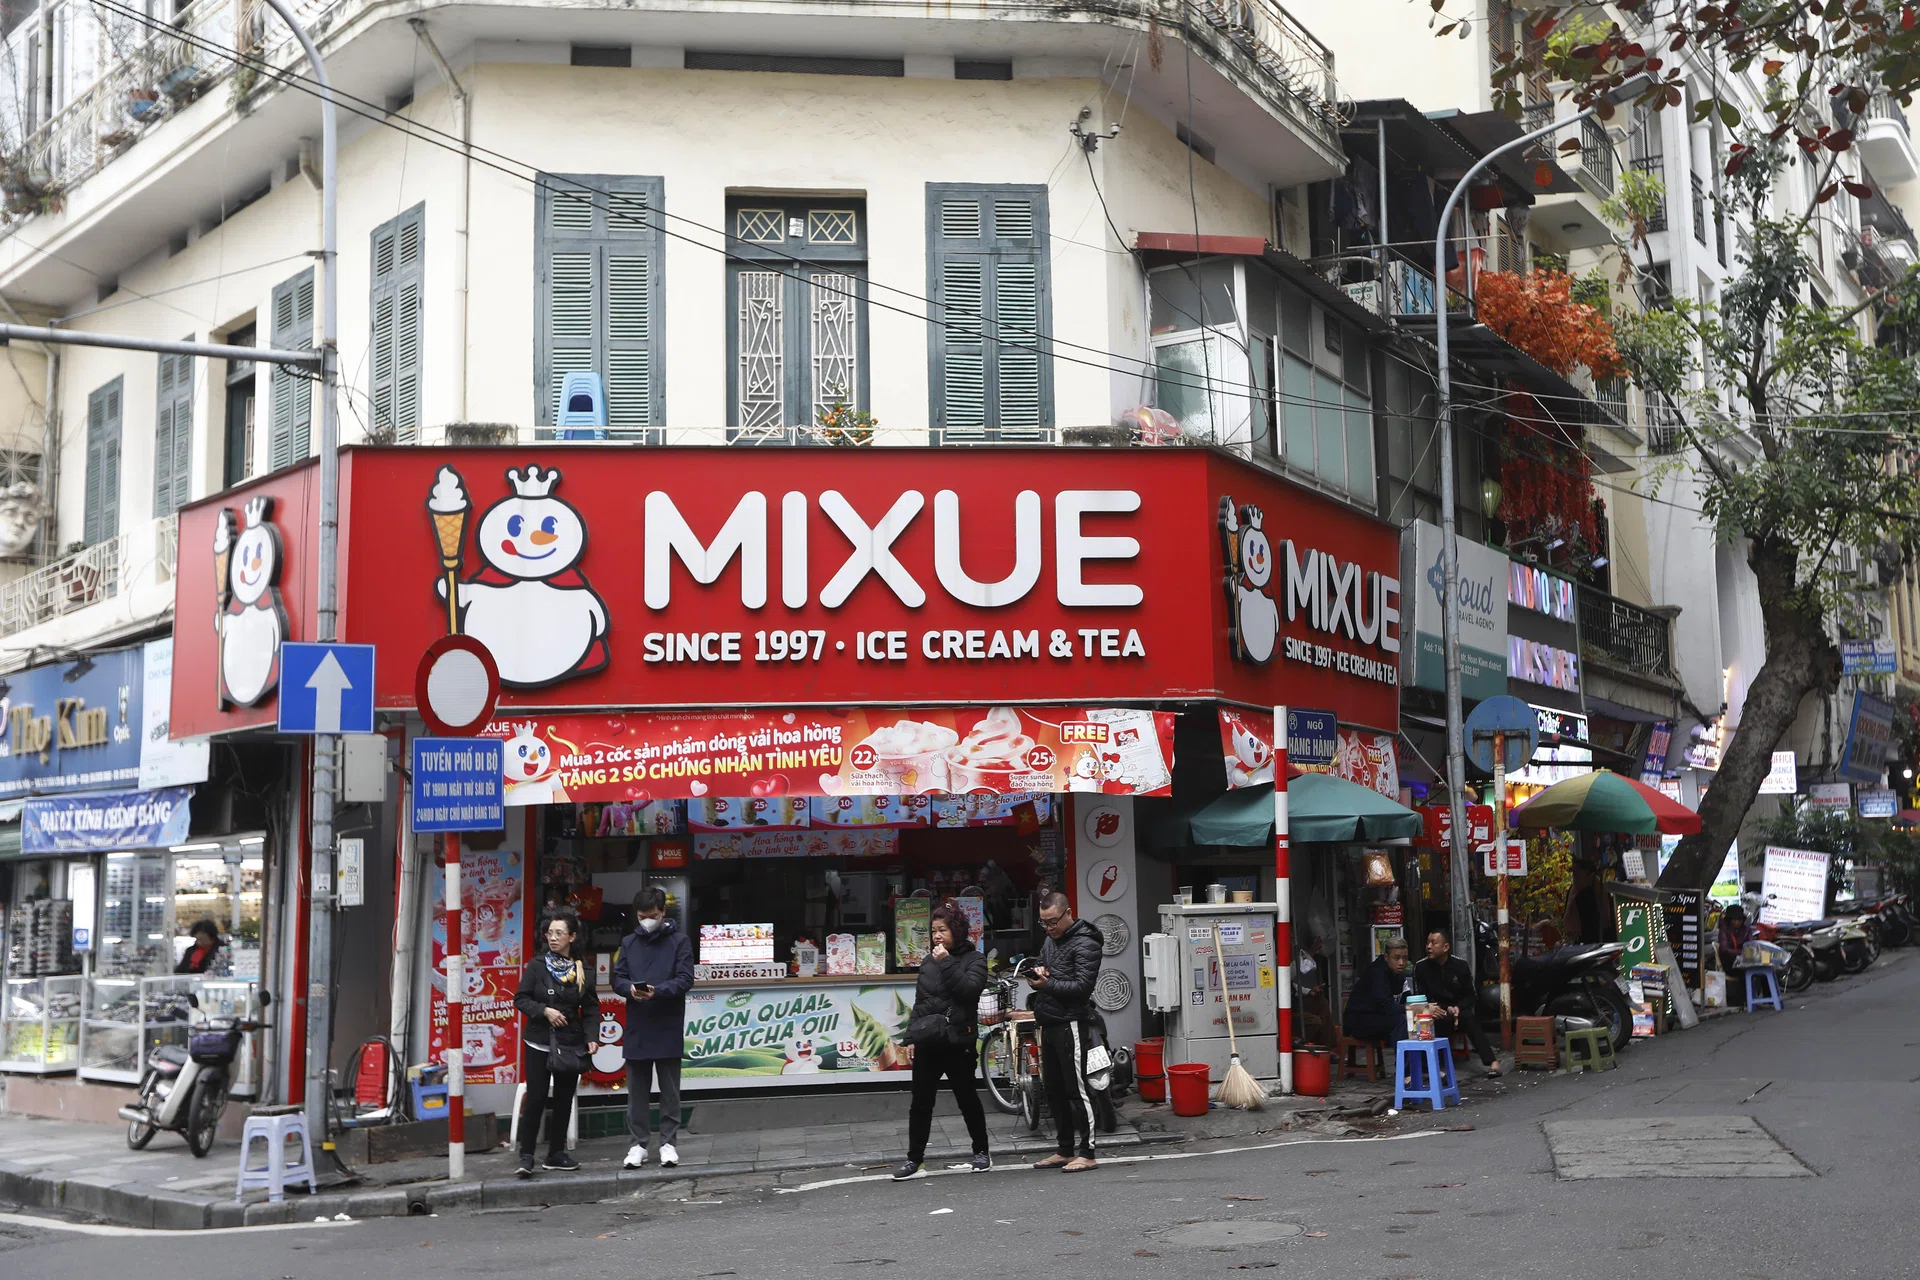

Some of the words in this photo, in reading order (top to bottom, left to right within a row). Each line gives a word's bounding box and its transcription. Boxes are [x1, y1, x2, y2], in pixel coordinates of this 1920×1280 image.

[644, 489, 1144, 609] MIXUE
[1434, 571, 1442, 584] Ms
[1286, 539, 1400, 653] MIXUE
[1552, 576, 1575, 623] SPA
[1458, 611, 1474, 625] RAVEL
[1475, 617, 1495, 631] AGENCY
[643, 632, 742, 662] SINCE
[755, 630, 826, 661] 1997
[856, 630, 907, 660] ICE
[922, 629, 1040, 659] CREAM
[1078, 629, 1146, 658] TEA
[1286, 636, 1311, 664] SINCE
[1314, 645, 1332, 668] 1997
[1337, 651, 1349, 673] ICE
[1350, 654, 1377, 680] CREAM
[1507, 634, 1580, 693] MASSAGE
[10, 704, 50, 765] Thọ
[56, 697, 108, 749] Kim
[481, 722, 510, 733] XUE
[1064, 725, 1107, 741] FREE
[1307, 718, 1323, 730] NGÕ
[559, 754, 592, 768] Mua
[594, 750, 604, 764] 2
[606, 744, 632, 763] cốc
[633, 743, 660, 761] sản
[662, 734, 706, 763] phẩm
[709, 732, 746, 753] dòng
[749, 729, 771, 746] vải
[773, 728, 800, 745] hoa
[803, 722, 842, 746] hồng
[1288, 733, 1310, 755] HÀNG
[1313, 735, 1335, 757] HÀNH
[1368, 748, 1381, 762] FREE
[421, 745, 452, 772] TUYẾN
[454, 746, 472, 772] PHỐ
[475, 752, 485, 771] ĐI
[486, 749, 498, 774] BỘ
[560, 767, 607, 790] TẶNG
[609, 767, 621, 783] 2
[649, 755, 712, 779] CHỨNG
[714, 751, 763, 777] NHẬN
[766, 747, 807, 770] TÌNH
[809, 744, 843, 767] YÊU
[449, 780, 462, 797] NGÀY
[1635, 834, 1661, 849] PHONG
[664, 849, 682, 857] MIXUE
[1769, 848, 1792, 858] MONEY
[1793, 851, 1826, 863] EXCHANGE
[1677, 894, 1696, 905] Spa
[711, 970, 729, 979] 024
[733, 969, 757, 978] 6666
[760, 968, 784, 977] 2111
[433, 1016, 448, 1027] TÌN
[462, 1012, 475, 1023] ÊU
[496, 1008, 514, 1021] BẠN
[685, 1009, 751, 1036] NGON
[700, 1021, 794, 1056] MATCHA
